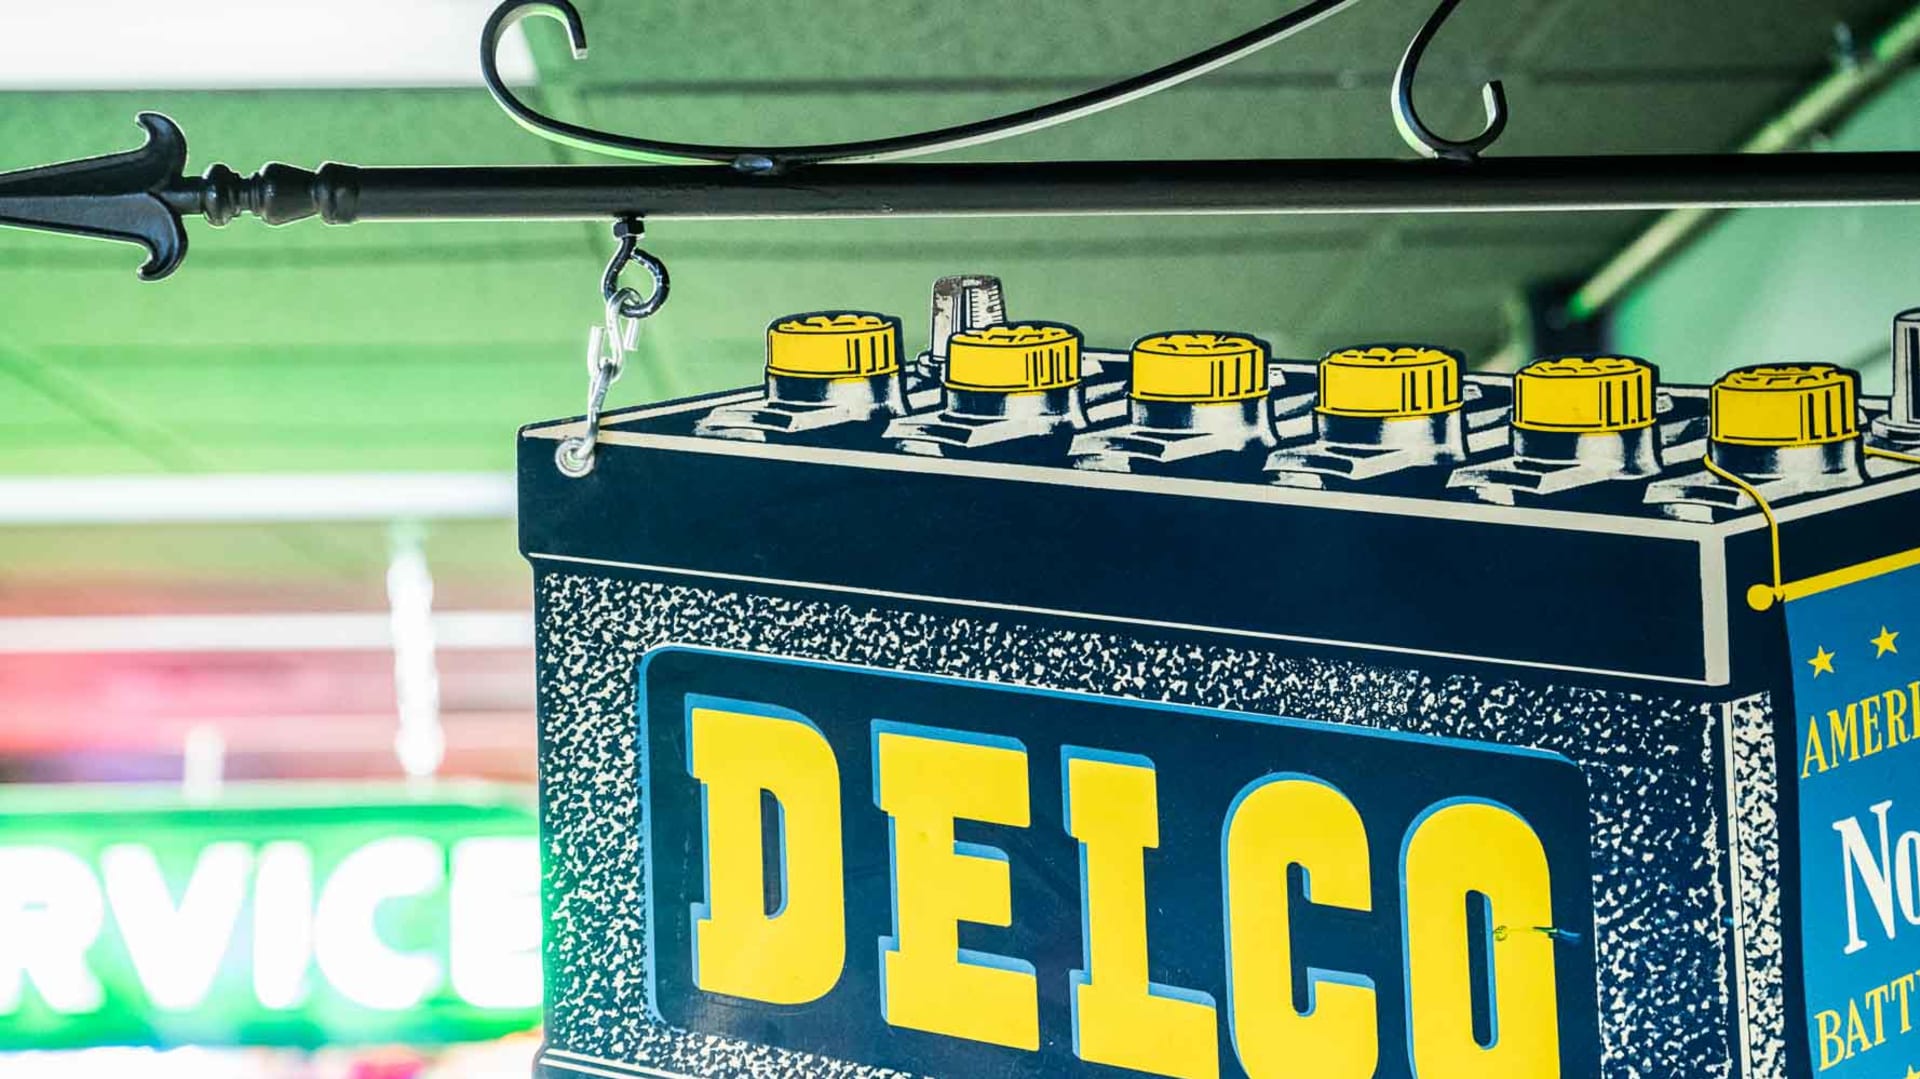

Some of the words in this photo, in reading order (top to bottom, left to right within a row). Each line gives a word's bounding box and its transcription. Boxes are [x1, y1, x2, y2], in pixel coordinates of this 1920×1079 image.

[0, 835, 542, 1014] RVICE
[684, 692, 1562, 1079] DELCO
[1813, 969, 1920, 1072] BATT
